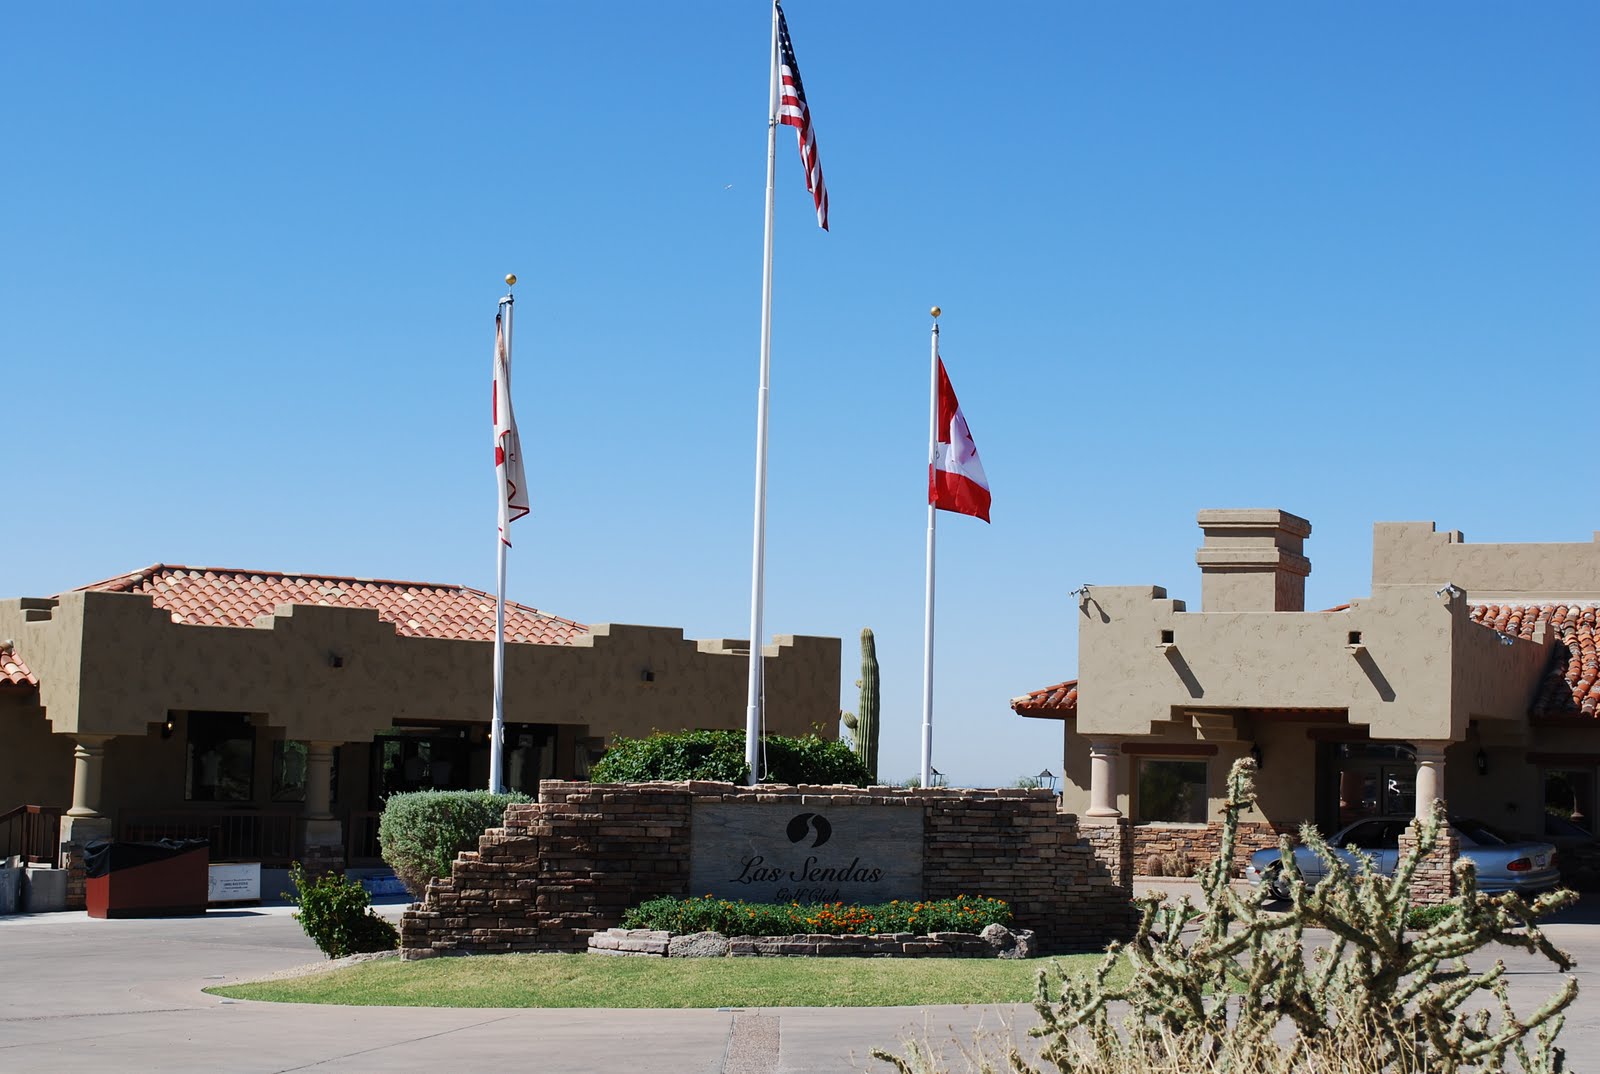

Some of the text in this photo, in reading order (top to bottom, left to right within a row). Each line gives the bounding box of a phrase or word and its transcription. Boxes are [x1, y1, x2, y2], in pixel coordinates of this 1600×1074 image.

[729, 856, 885, 884] Las Sendas
[774, 888, 840, 903] Golf Club
